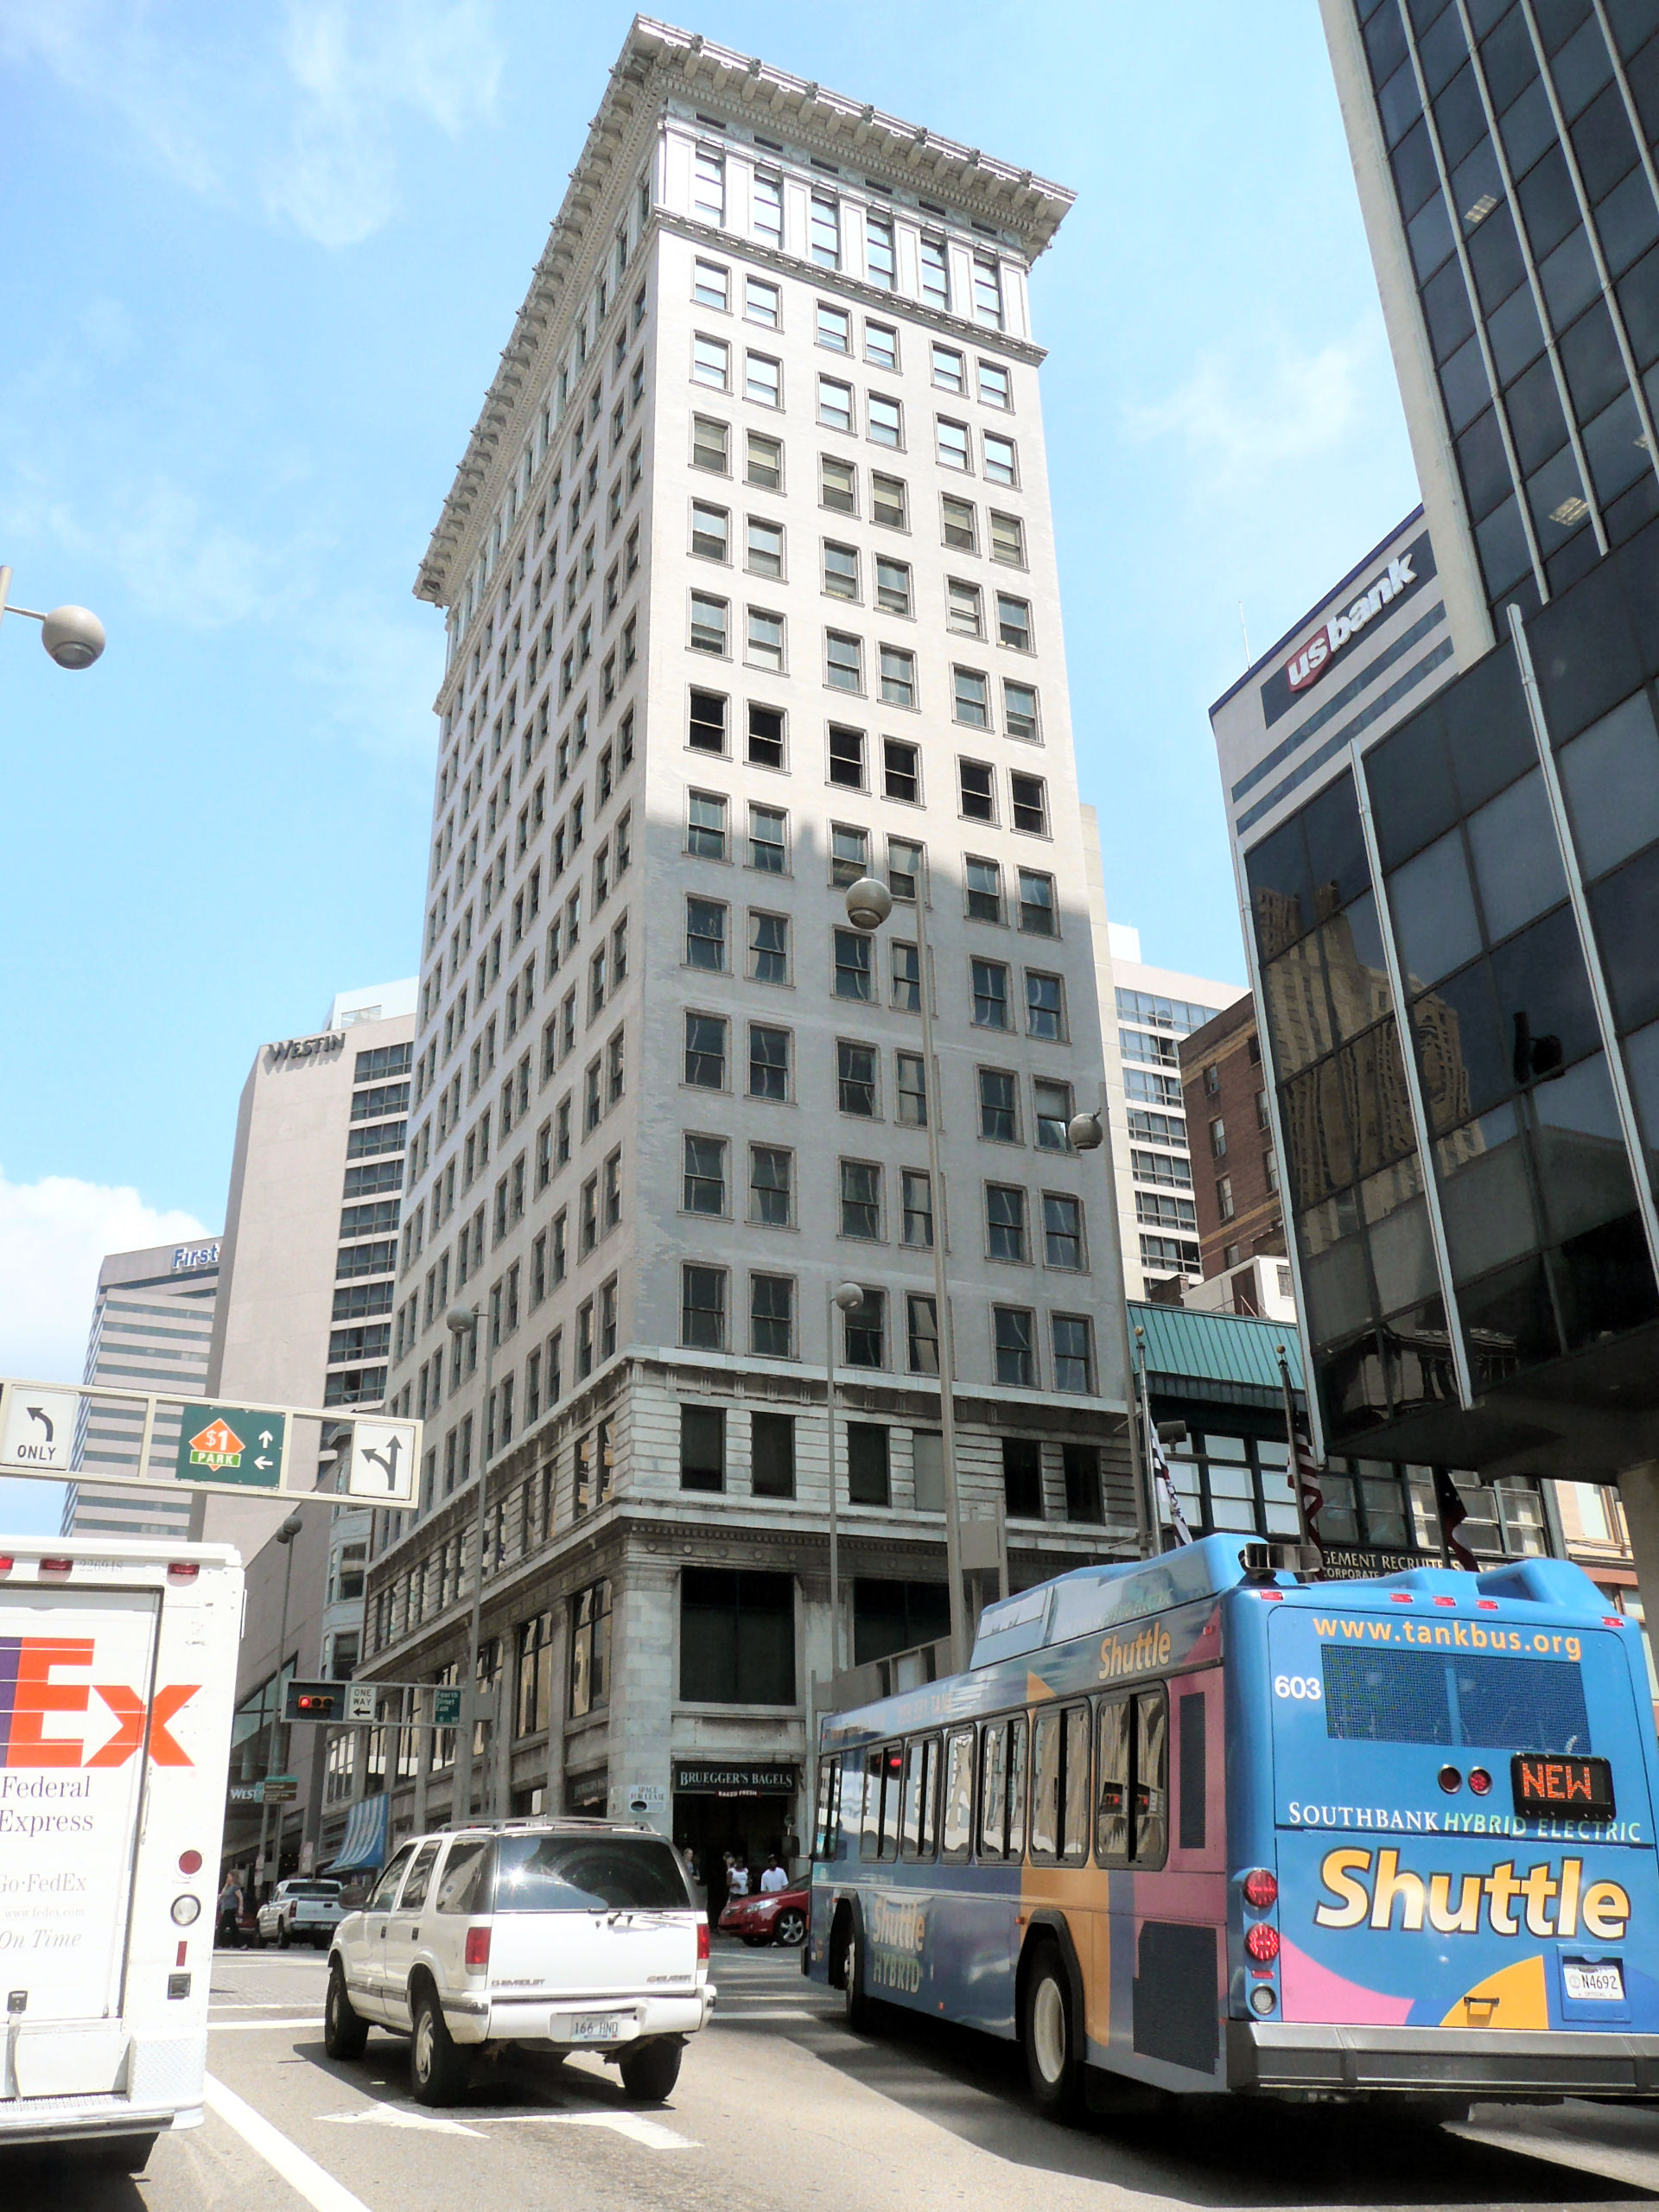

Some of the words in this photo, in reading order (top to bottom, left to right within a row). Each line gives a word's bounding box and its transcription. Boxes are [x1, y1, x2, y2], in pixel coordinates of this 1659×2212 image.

[268, 1033, 346, 1062] WESTIN
[173, 1244, 219, 1268] First
[205, 1429, 228, 1452] $1
[17, 1444, 56, 1461] ONLY
[198, 1452, 234, 1465] PARK
[1098, 1621, 1172, 1680] Shuttle
[1313, 1618, 1583, 1661] www.tankbus.org
[354, 1688, 372, 1697] ONE
[1274, 1675, 1322, 1700] 603
[353, 1697, 372, 1706] WAY
[1, 1776, 91, 1798] Federal
[680, 1771, 748, 1786] BRUEGGER'S
[752, 1773, 793, 1787] BAGELS
[1521, 1762, 1592, 1801] NEW
[0, 1809, 94, 1838] Express
[1288, 1802, 1440, 1832] SOUTHBANK
[1445, 1812, 1528, 1837] HYBRID
[1537, 1816, 1642, 1842] ELECTRIC
[1313, 1846, 1632, 1942] Shuttle
[4, 1906, 85, 1918] www.fedex.com
[872, 1897, 925, 1952] Shuttle
[0, 1929, 25, 1949] On
[32, 1929, 82, 1948] Time
[873, 1950, 920, 1993] HYBRID
[1581, 1974, 1618, 1990] N4692
[575, 2022, 594, 2034] 166
